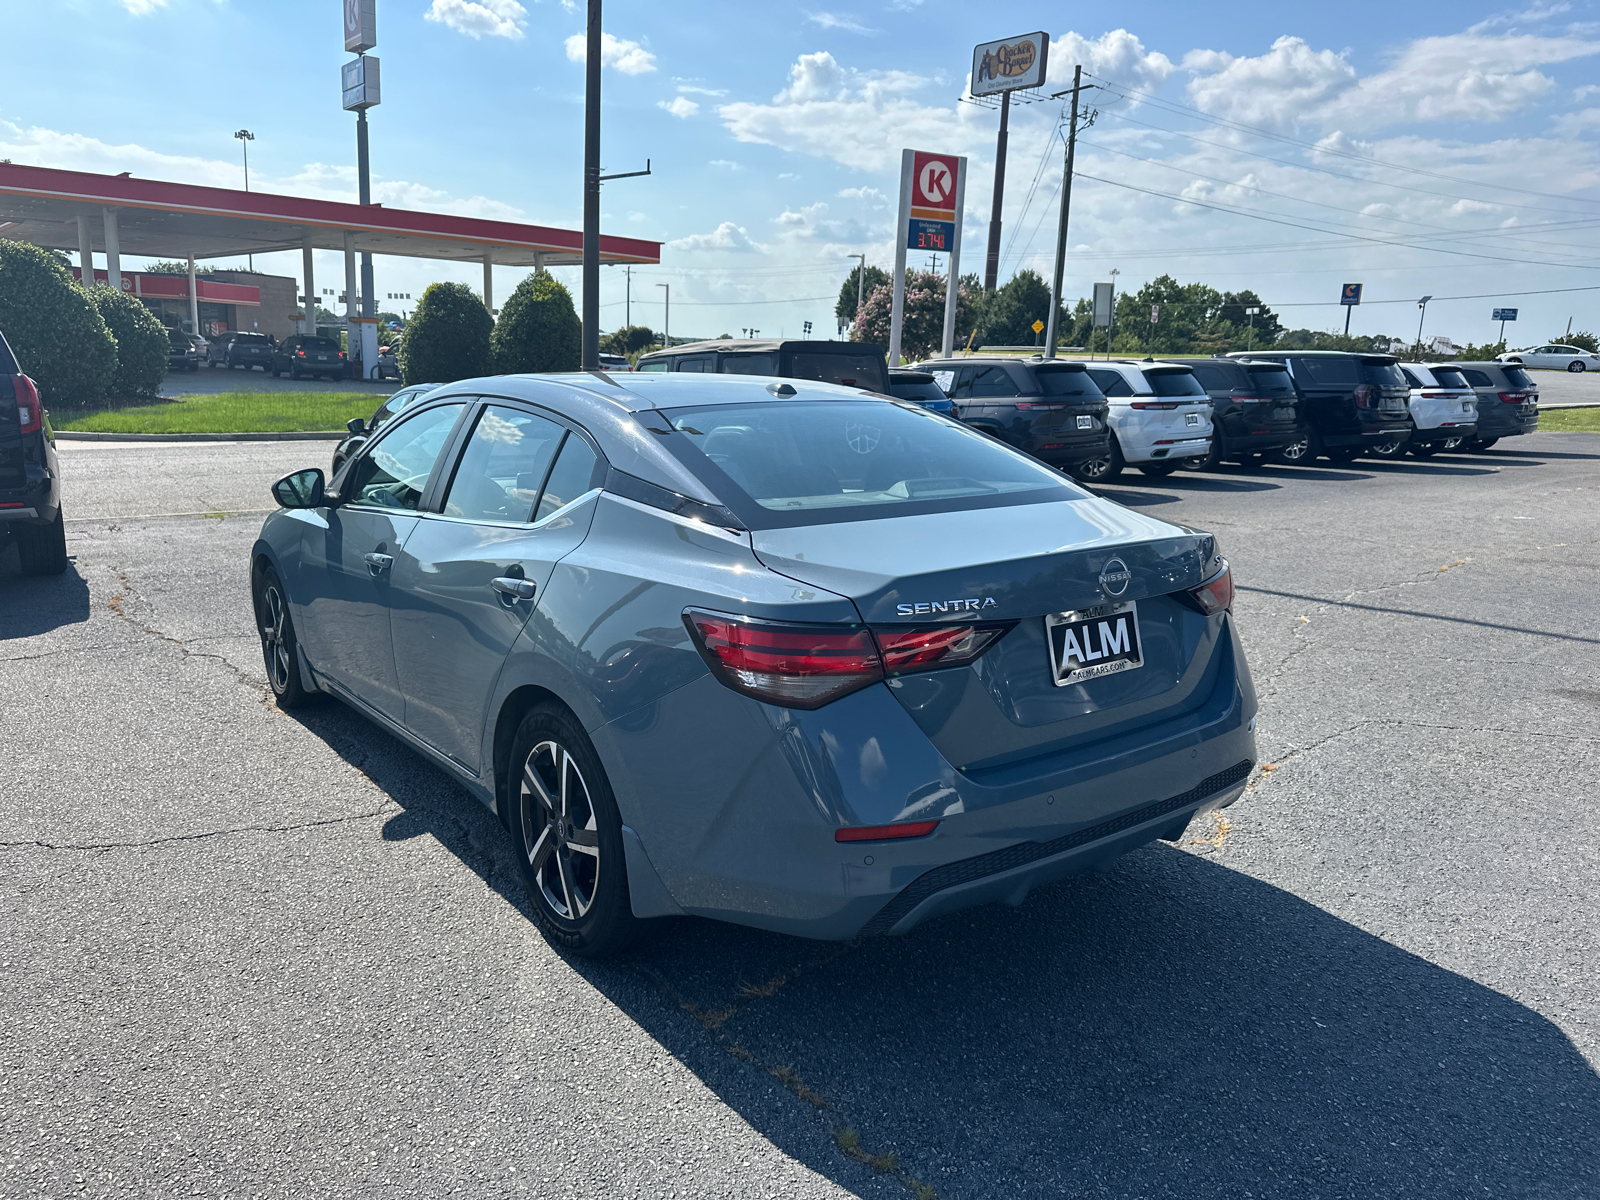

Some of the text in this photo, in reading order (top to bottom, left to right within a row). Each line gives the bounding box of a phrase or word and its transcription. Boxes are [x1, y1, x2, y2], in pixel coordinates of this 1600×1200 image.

[997, 45, 1031, 64] Cracker
[1003, 53, 1032, 76] Barrel
[928, 168, 947, 199] K
[1100, 571, 1131, 583] NISSAN
[897, 597, 998, 616] SENTRA
[1081, 605, 1104, 619] ALM
[1062, 617, 1131, 667] ALM
[1077, 662, 1125, 679] ALMCARS.COM
